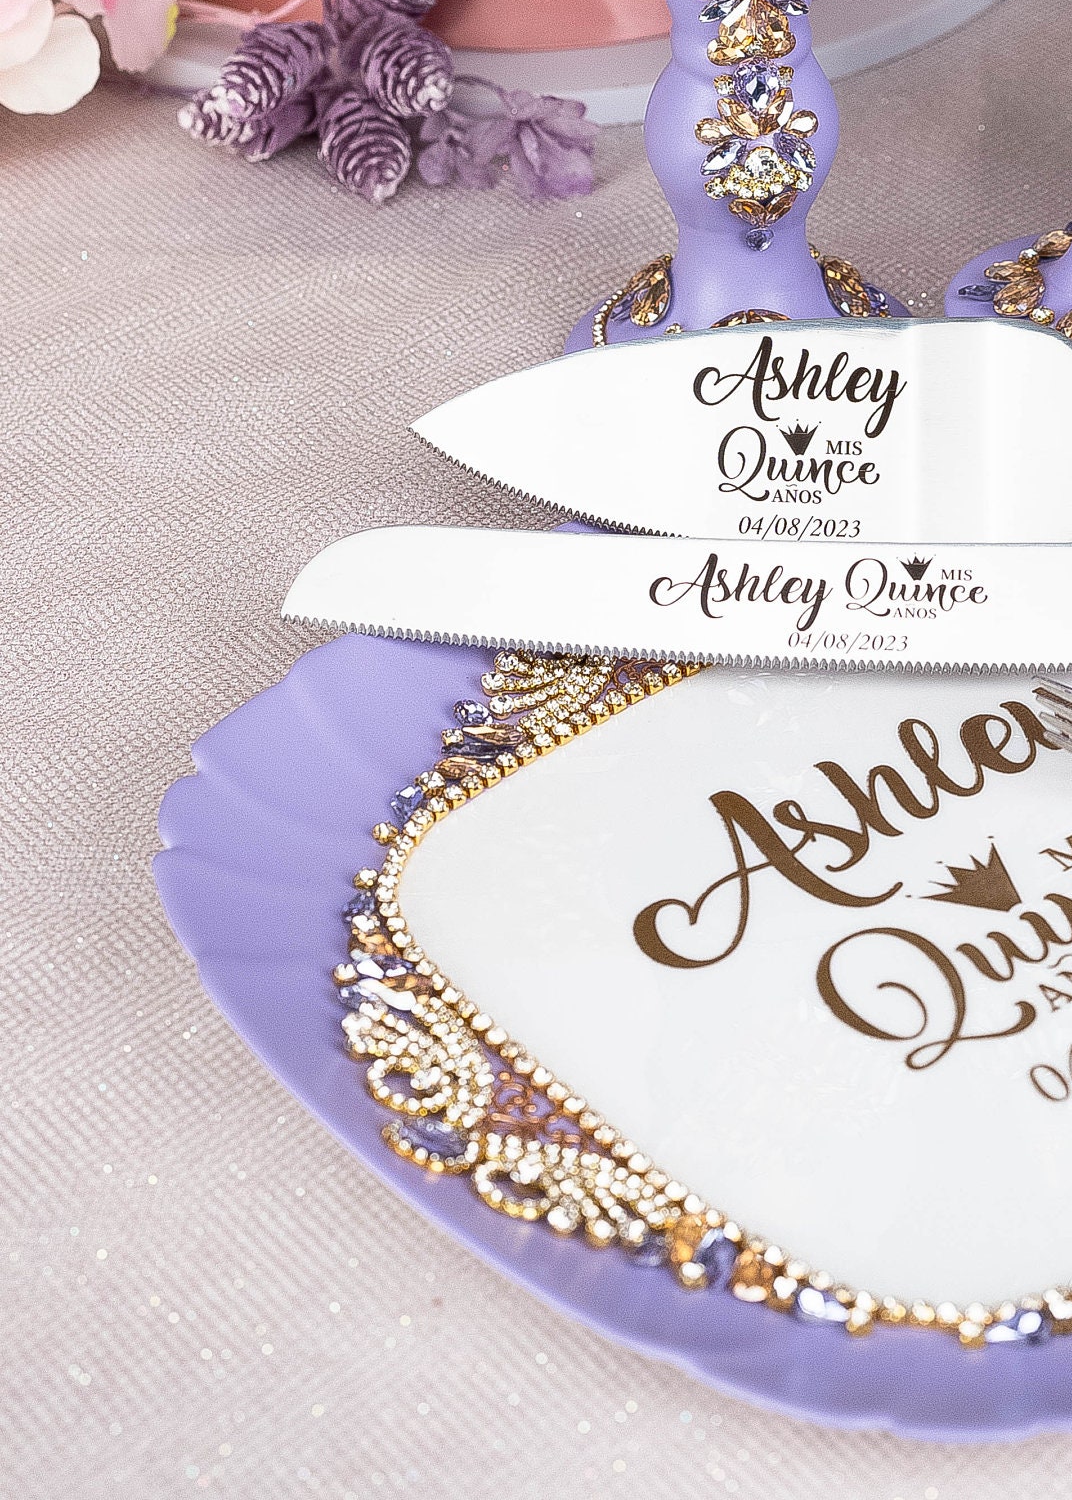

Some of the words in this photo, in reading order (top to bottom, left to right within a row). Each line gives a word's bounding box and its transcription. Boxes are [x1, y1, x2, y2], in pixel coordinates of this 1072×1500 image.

[693, 336, 907, 438] Ashley
[826, 440, 863, 455] MIS
[718, 426, 880, 501] Quince
[771, 484, 823, 504] AÑOS
[738, 514, 861, 542] 04/08/2023
[940, 569, 973, 581] MIS
[649, 553, 834, 632] Ashley
[845, 558, 988, 617] Quince
[788, 631, 908, 654] 04/08/2023
